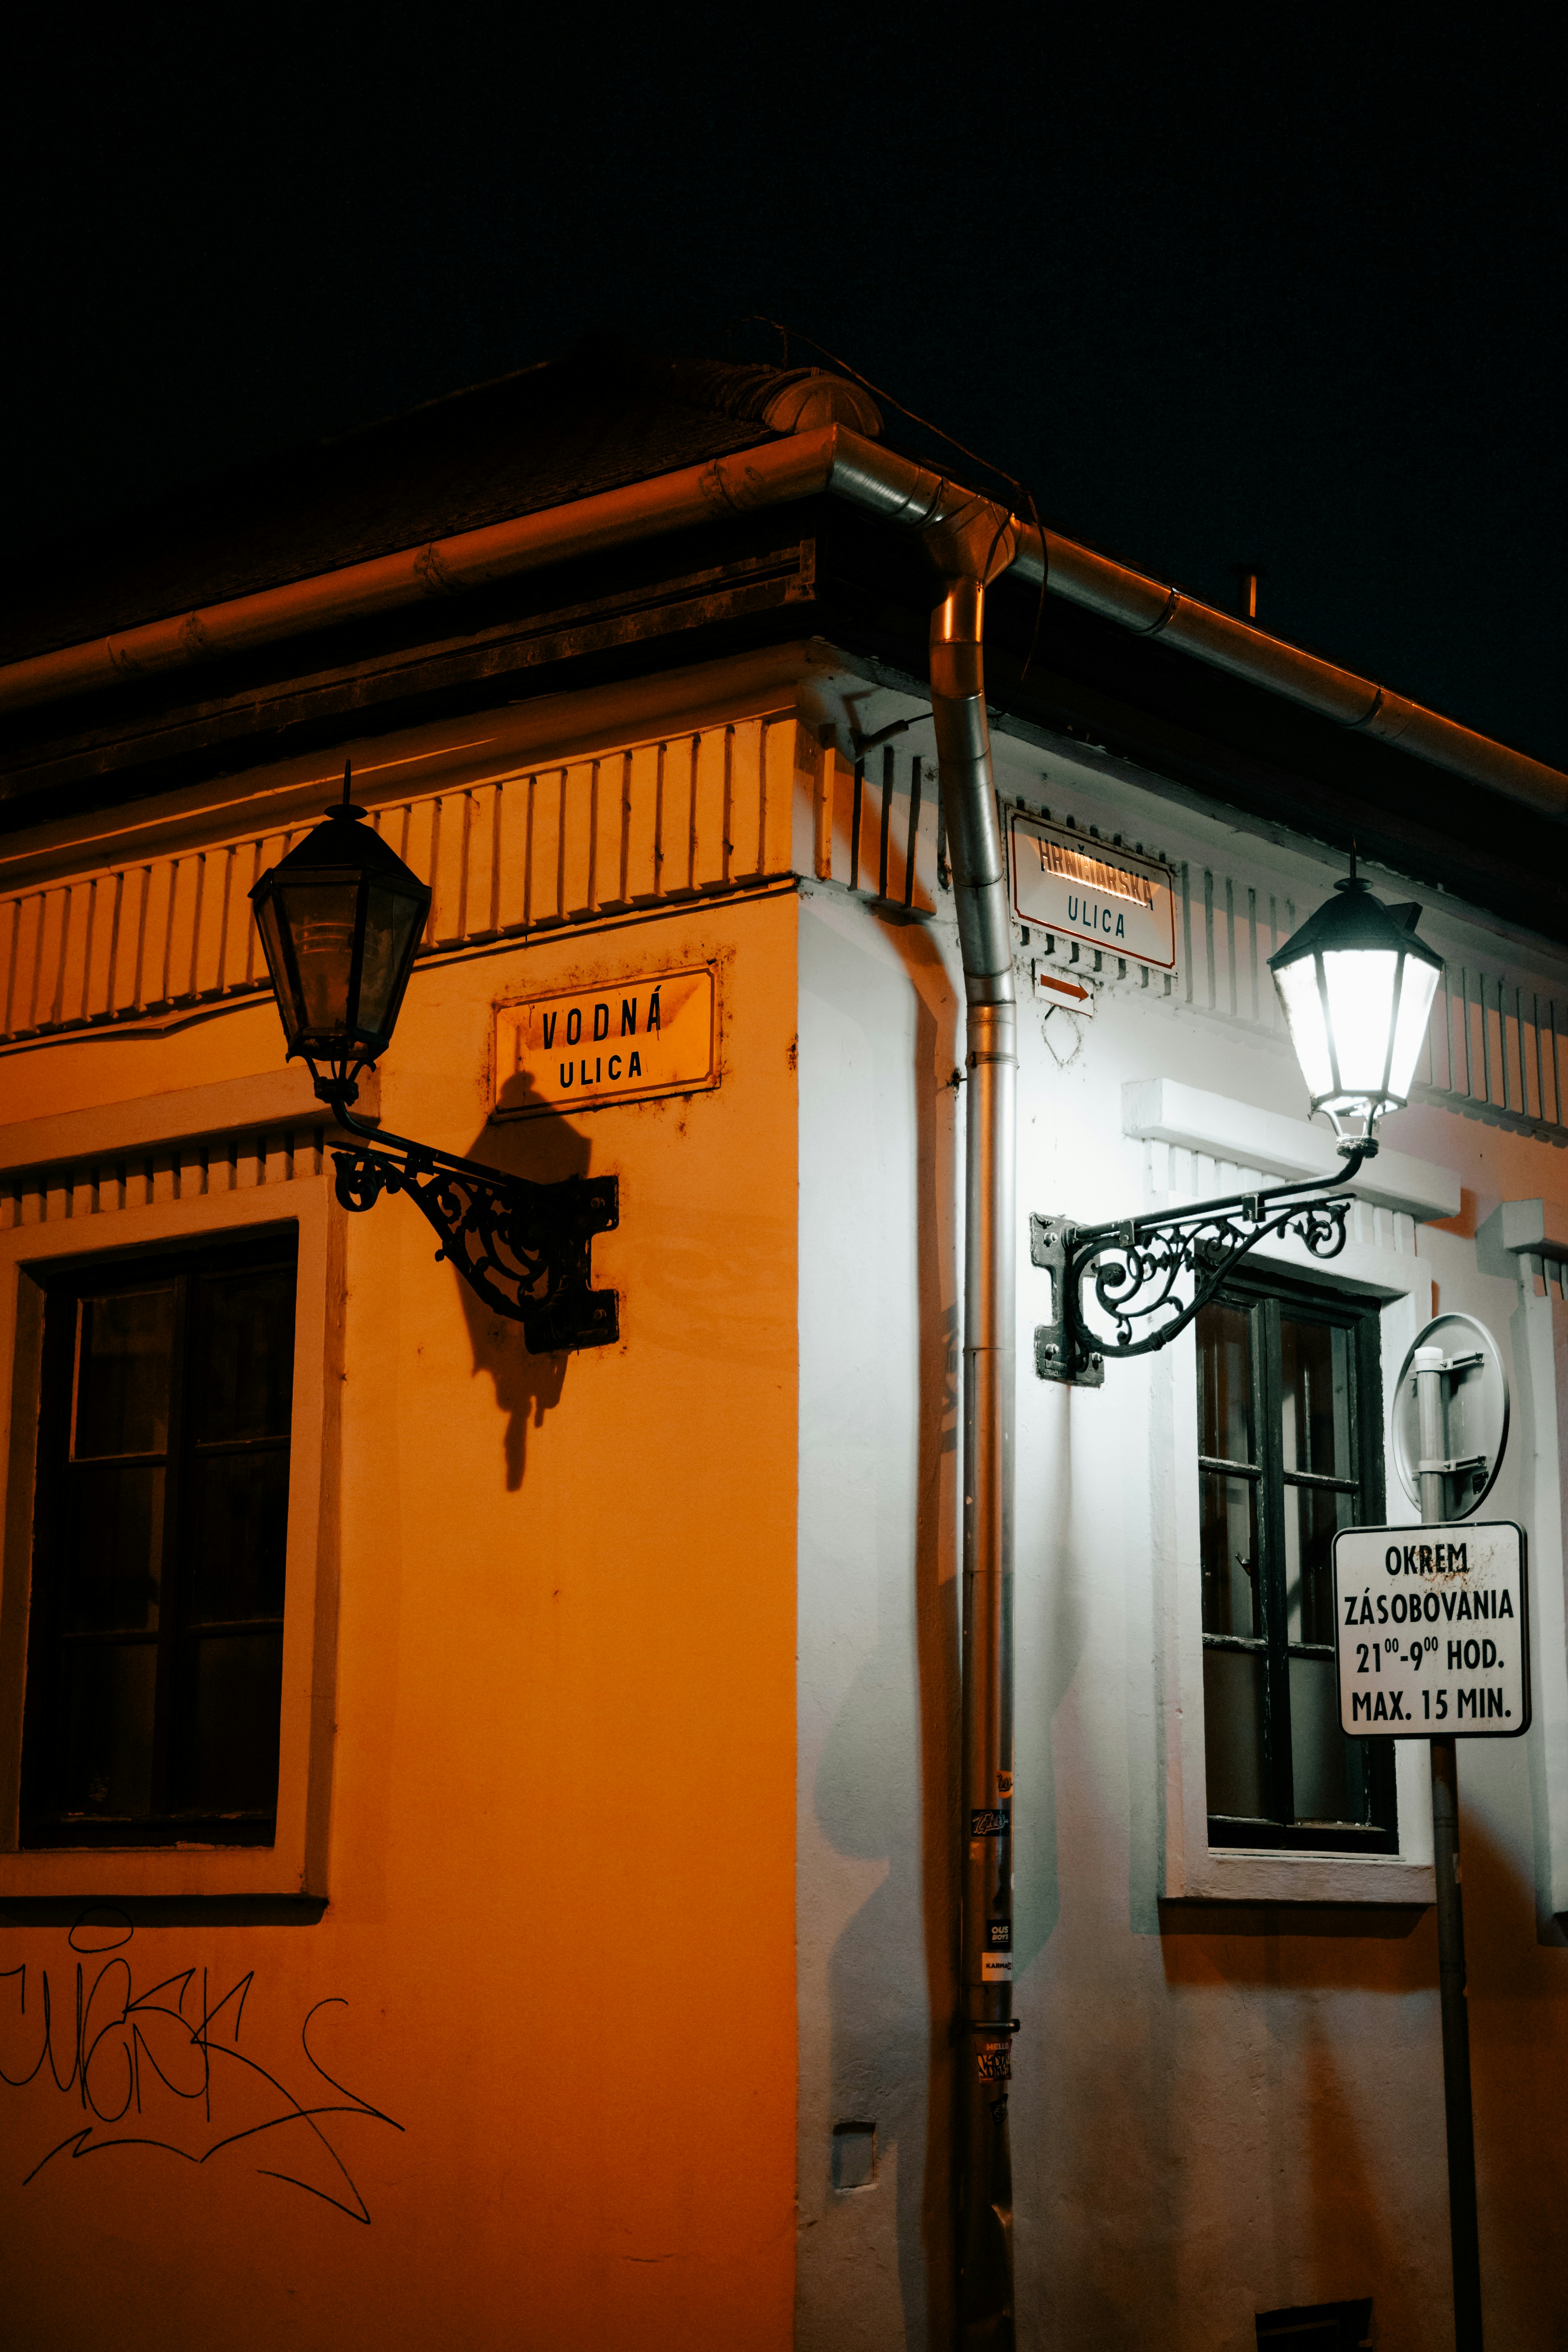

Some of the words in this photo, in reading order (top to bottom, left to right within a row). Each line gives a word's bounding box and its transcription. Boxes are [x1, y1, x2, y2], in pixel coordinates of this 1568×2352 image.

[1038, 836, 1154, 911] HRNČIARSKA
[1069, 896, 1125, 938] ULICA
[543, 985, 662, 1050] VODNÁ
[560, 1051, 642, 1088] ULICA
[1385, 1543, 1470, 1575] OKREM
[1344, 1587, 1514, 1625] ZÁSOBOVANIA
[1447, 1639, 1504, 1670] HOD.
[1352, 1691, 1412, 1721] MAX.
[1422, 1690, 1448, 1719] 15
[1458, 1687, 1512, 1718] MIN.
